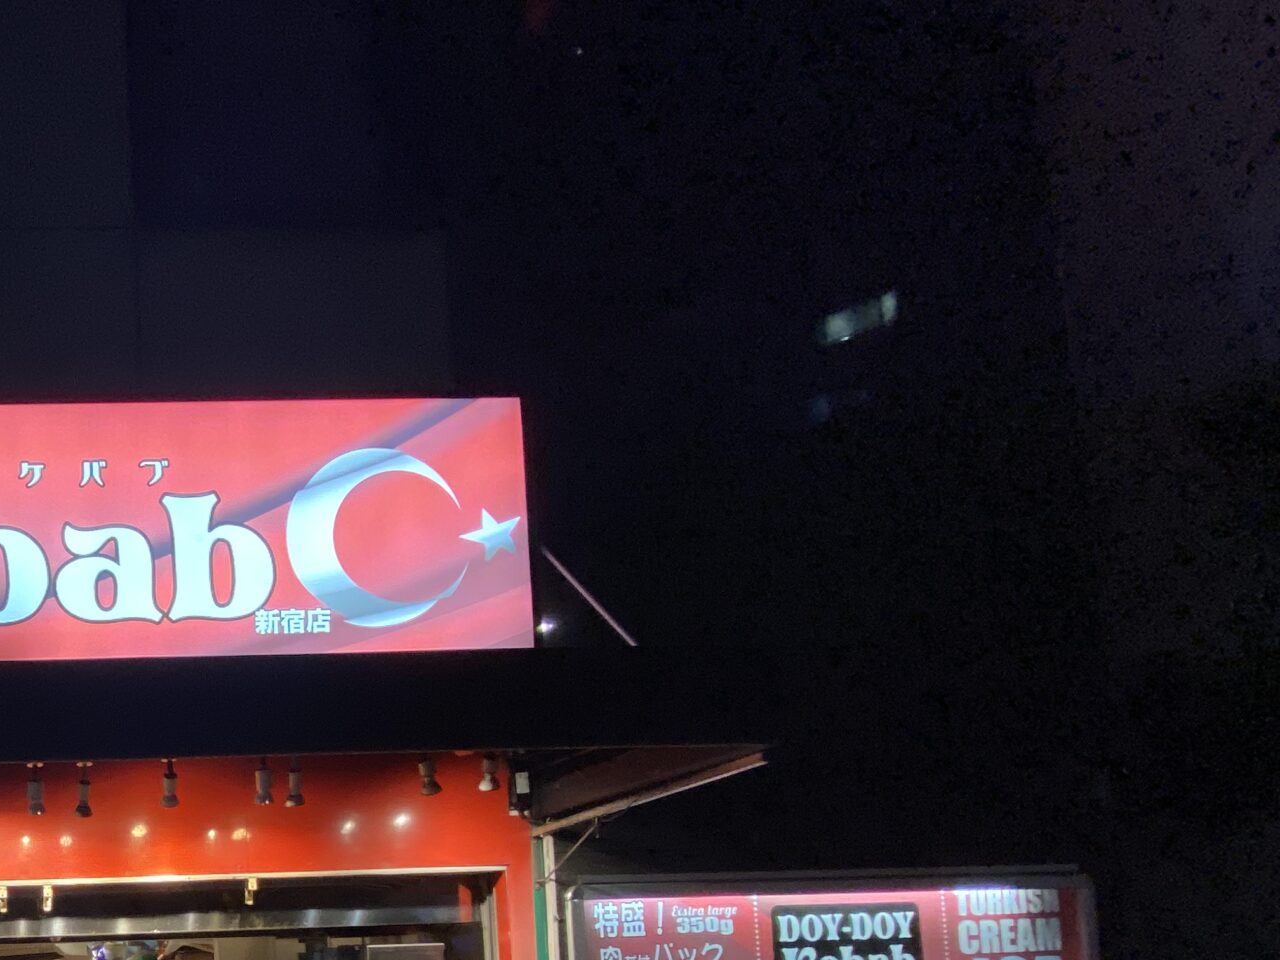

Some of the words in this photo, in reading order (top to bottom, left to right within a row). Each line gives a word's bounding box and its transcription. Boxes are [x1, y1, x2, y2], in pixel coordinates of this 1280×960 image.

[254, 609, 331, 635] 新宿店
[677, 917, 734, 935] 350g
[777, 912, 914, 942] DOY-DOY
[958, 918, 1062, 954] CREAM
